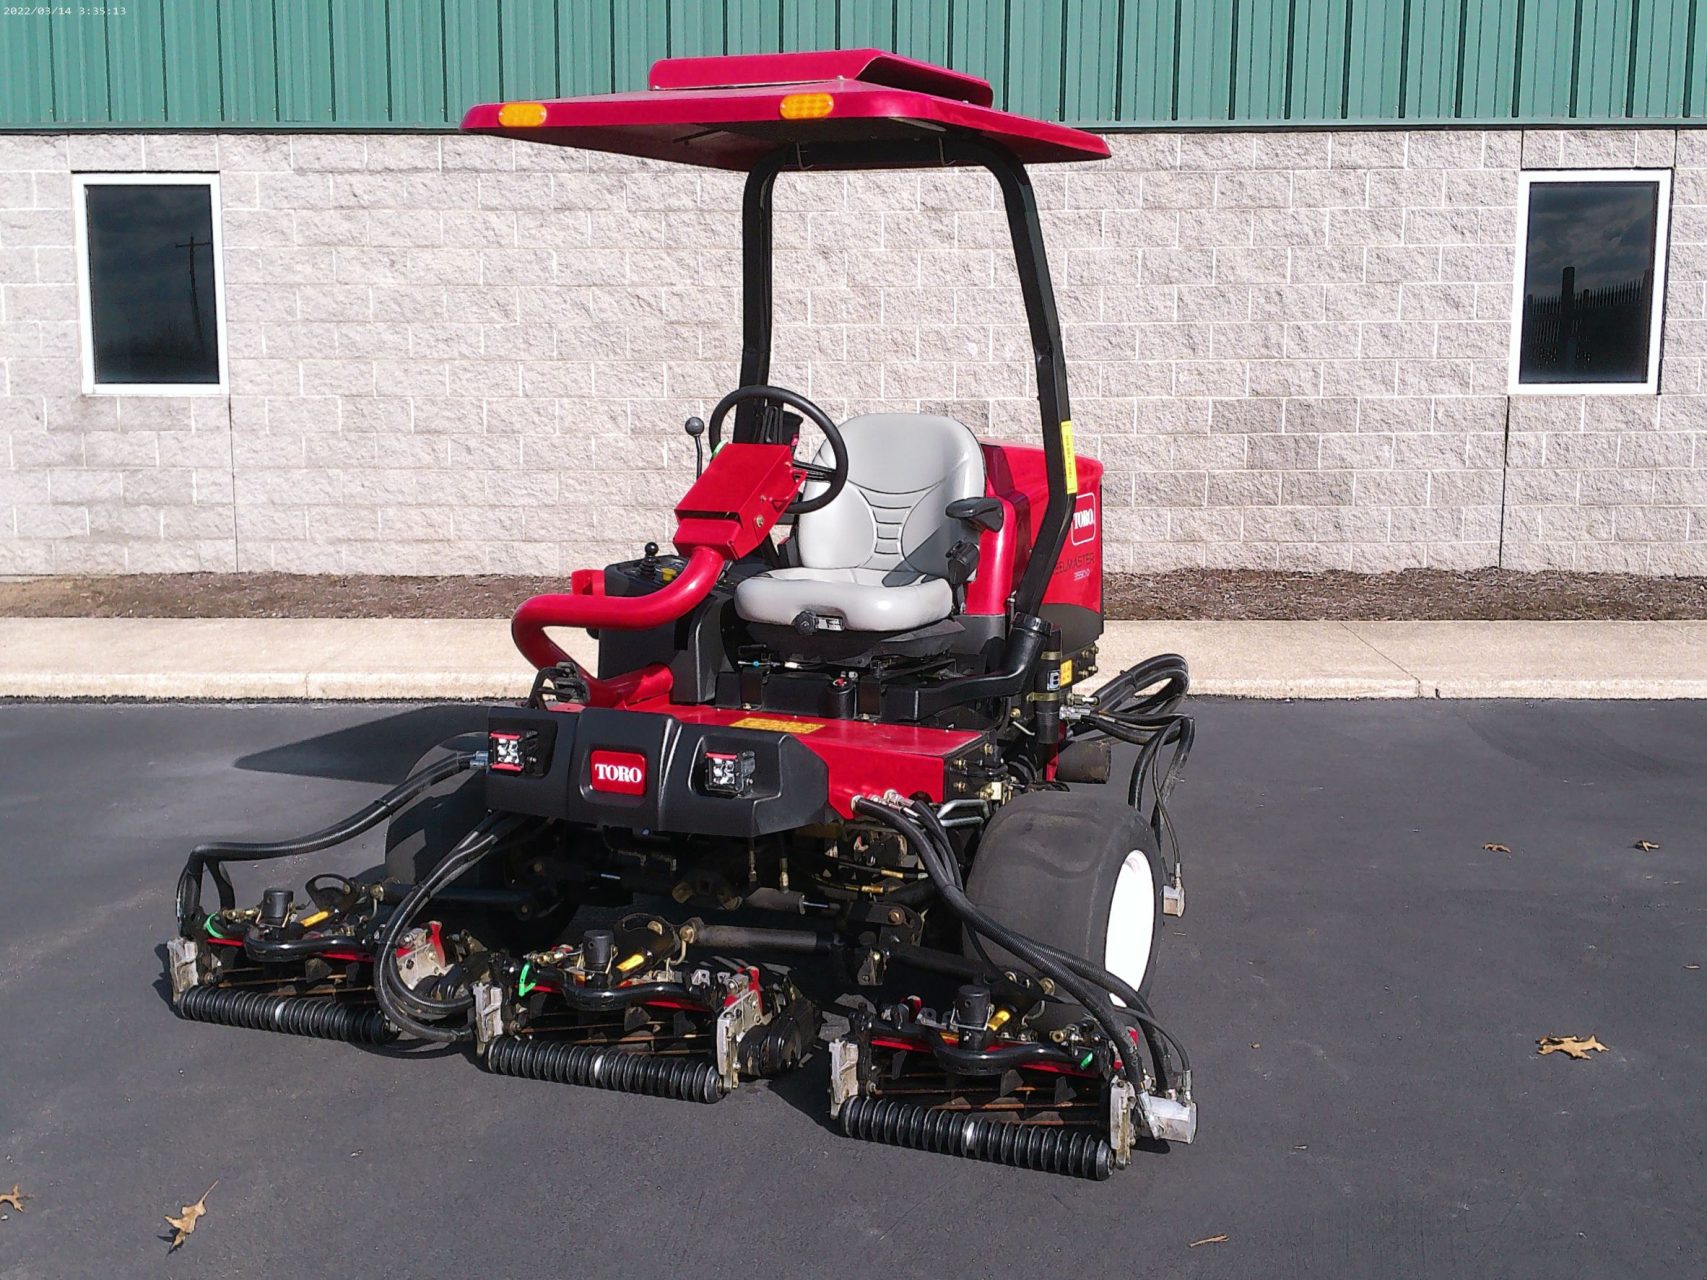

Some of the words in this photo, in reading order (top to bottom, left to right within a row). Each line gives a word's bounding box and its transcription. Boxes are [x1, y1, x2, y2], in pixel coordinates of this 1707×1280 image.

[1073, 508, 1094, 529] TORO
[1054, 552, 1096, 575] EELMASTER
[595, 763, 642, 783] TORO
